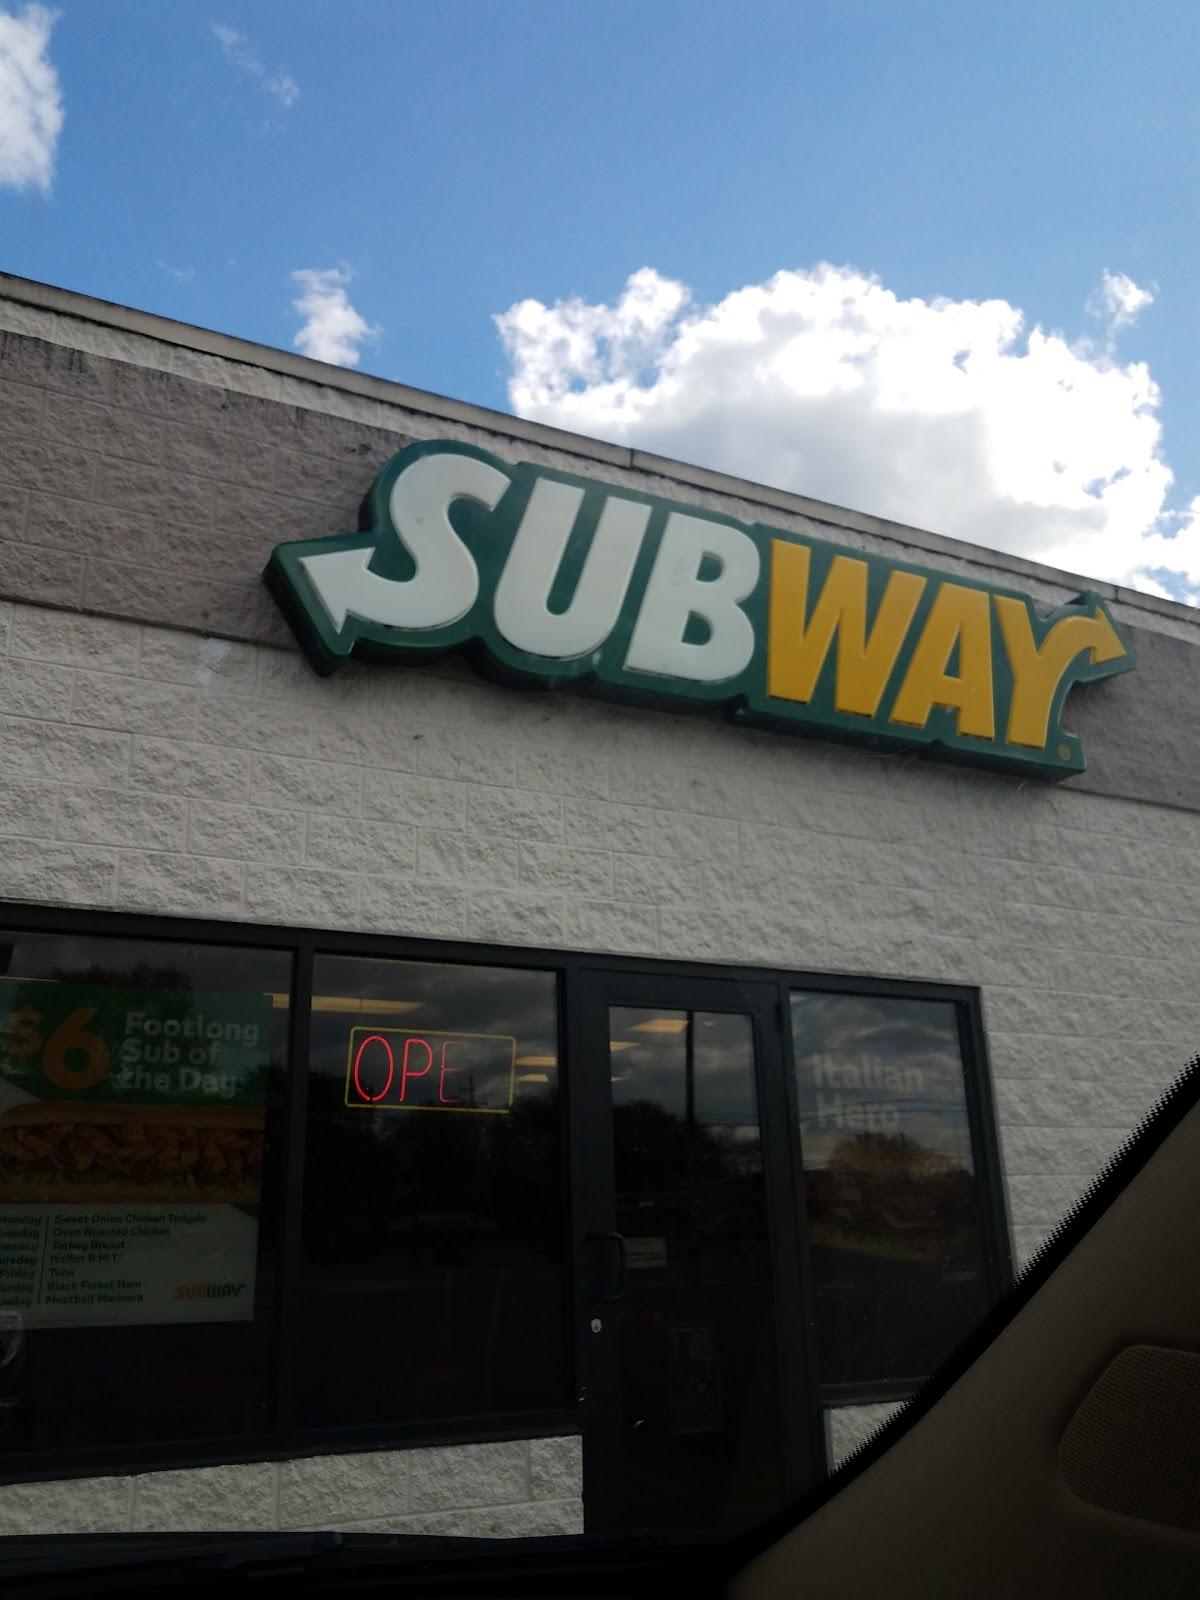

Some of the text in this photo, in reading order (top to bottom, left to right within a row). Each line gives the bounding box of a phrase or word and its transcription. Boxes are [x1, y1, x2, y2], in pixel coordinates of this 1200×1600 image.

[300, 454, 1127, 750] SUBWAY
[124, 1010, 260, 1047] Footlong
[118, 1036, 222, 1066] Sub of
[114, 1064, 238, 1099] the Day
[813, 1055, 922, 1095] Italian
[816, 1091, 899, 1132] Hero
[55, 1215, 89, 1224] Sweet
[125, 1214, 166, 1223] Chicken
[168, 1214, 208, 1224] Teriyaki
[53, 1226, 170, 1237] Oven Roasted Chicken
[51, 1240, 125, 1251] Turkey Breast
[48, 1268, 75, 1277] Tuna
[47, 1280, 143, 1291] Black Forest Ham
[46, 1293, 145, 1304] Meatball Marinara
